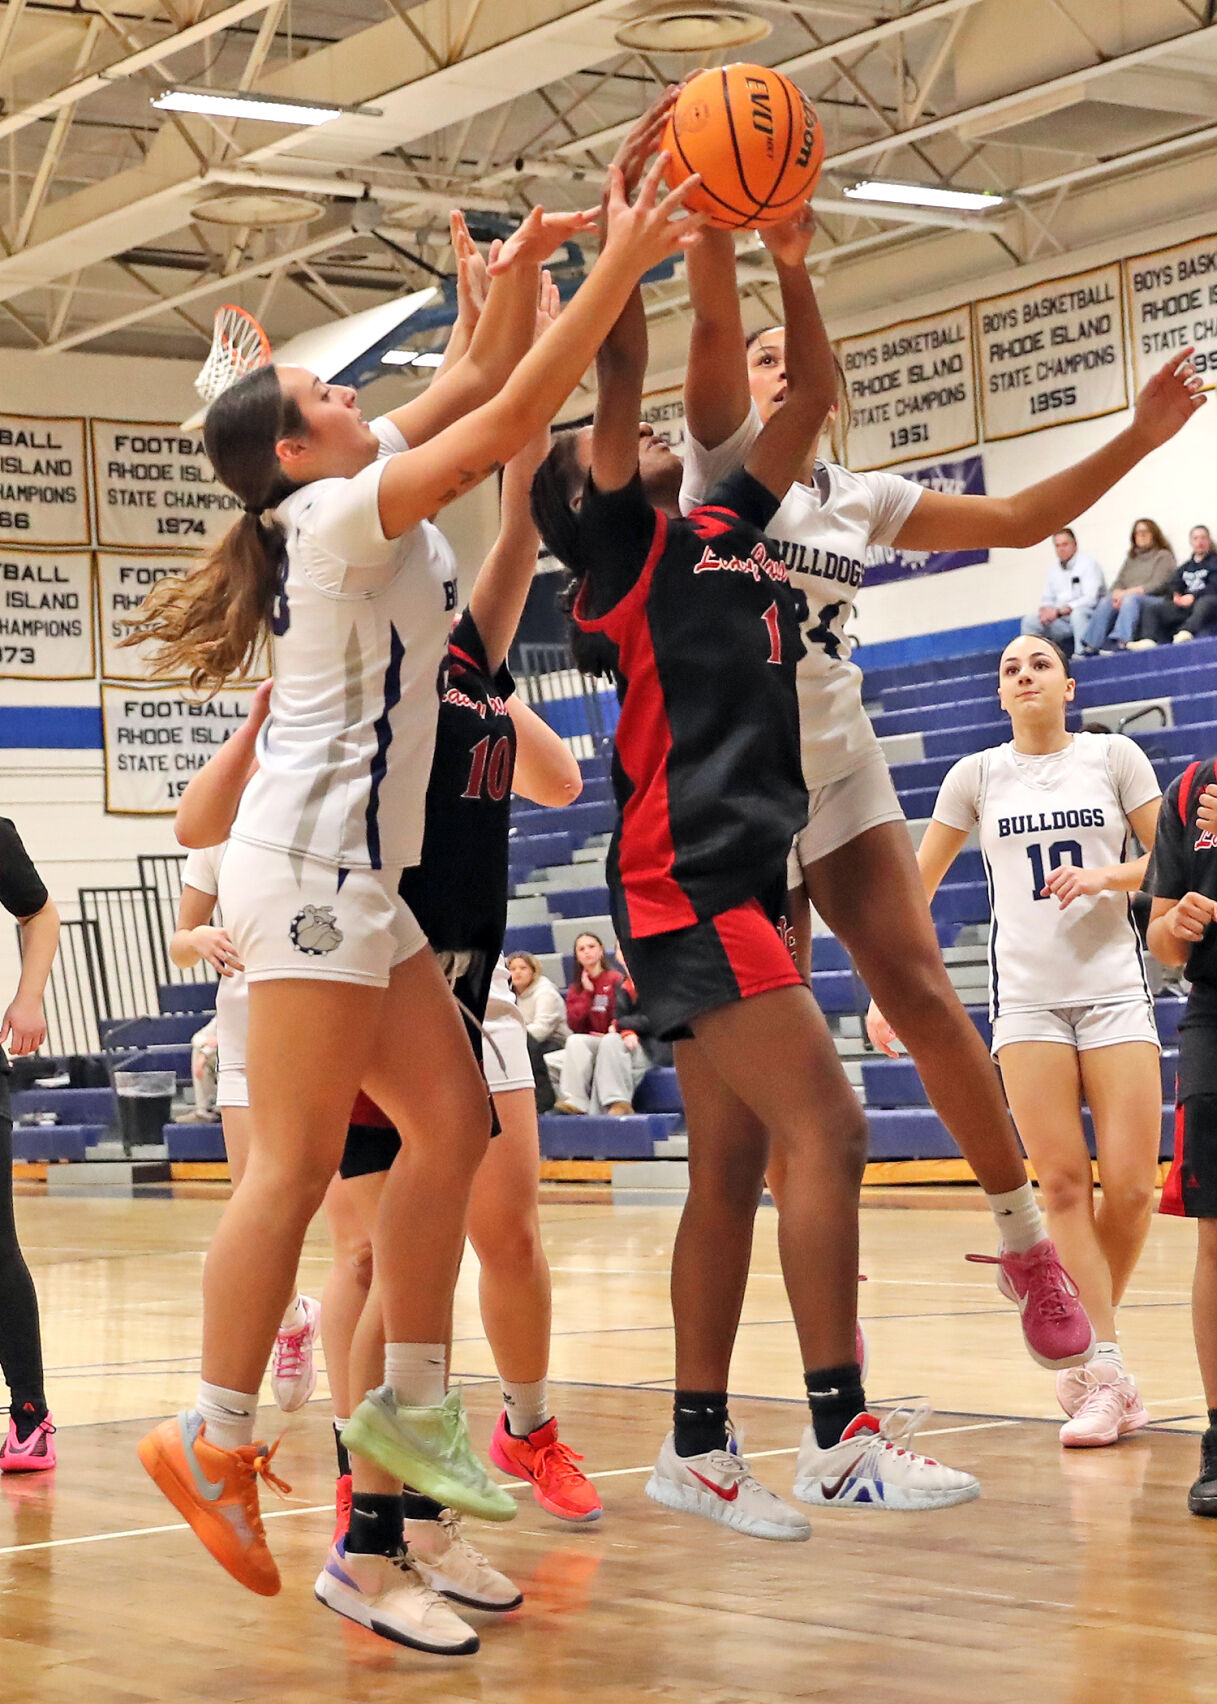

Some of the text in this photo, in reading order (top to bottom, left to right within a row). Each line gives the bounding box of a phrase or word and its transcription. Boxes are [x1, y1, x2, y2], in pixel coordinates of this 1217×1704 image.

[1134, 265, 1173, 293] BOYS
[983, 280, 1115, 335] BOYS BASKETBALL
[1142, 288, 1203, 323] RHODE
[845, 324, 965, 371] BOYS BASKETBALL
[990, 313, 1112, 363] RHODE ISLAND
[1142, 325, 1188, 354] STATE
[852, 354, 963, 399] RHODE ISLAND
[989, 344, 1115, 394] STATE CHAMPIONS
[851, 382, 966, 429] STATE CHAMPIONS
[1030, 386, 1077, 415] 1955
[0, 429, 62, 449] BALL
[890, 423, 929, 449] 1951
[0, 456, 72, 477] ISLAND
[108, 461, 174, 481] RHODE
[107, 488, 157, 507] STATE
[157, 517, 206, 535] 1974
[0, 563, 70, 583] BALL
[6, 590, 80, 610] ISLAND
[760, 599, 782, 664] 1
[0, 646, 35, 664] 73
[124, 701, 249, 718] FOOTBALL
[117, 727, 237, 745] RHODE ISLA
[117, 754, 169, 771] STATE
[460, 735, 512, 801] 10
[997, 808, 1105, 837] BULLDOGS
